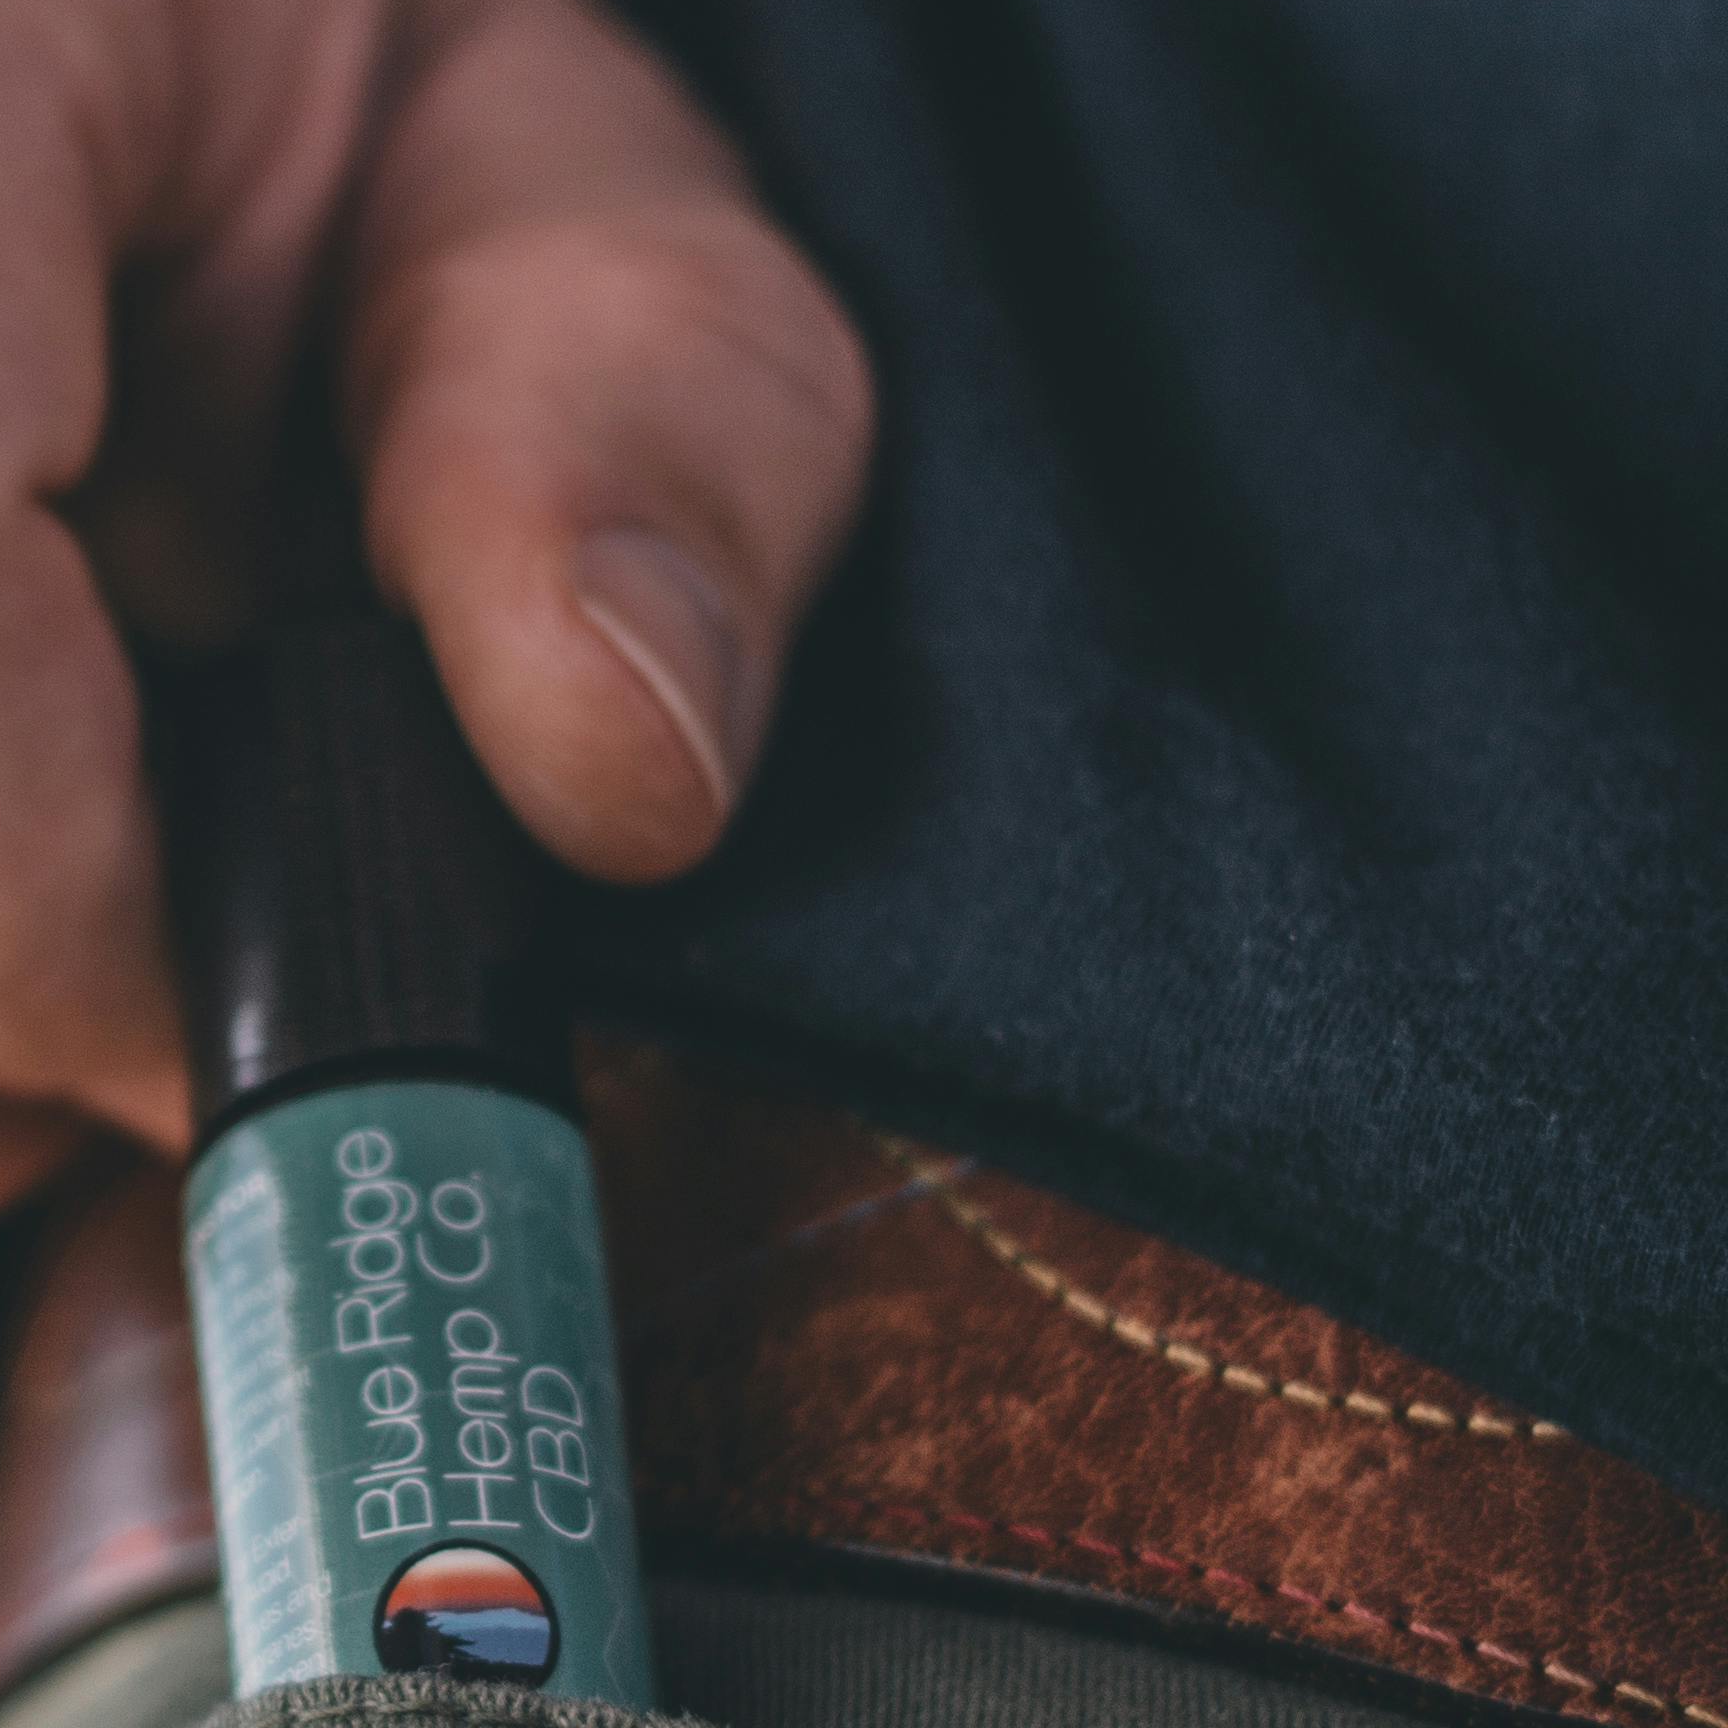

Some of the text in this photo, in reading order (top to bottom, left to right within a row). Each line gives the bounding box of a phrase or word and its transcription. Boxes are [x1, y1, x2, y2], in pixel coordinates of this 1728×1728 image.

[330, 1128, 434, 1540] Blue Ridge
[442, 1308, 521, 1530] Hemp
[521, 1365, 596, 1541] CBD
